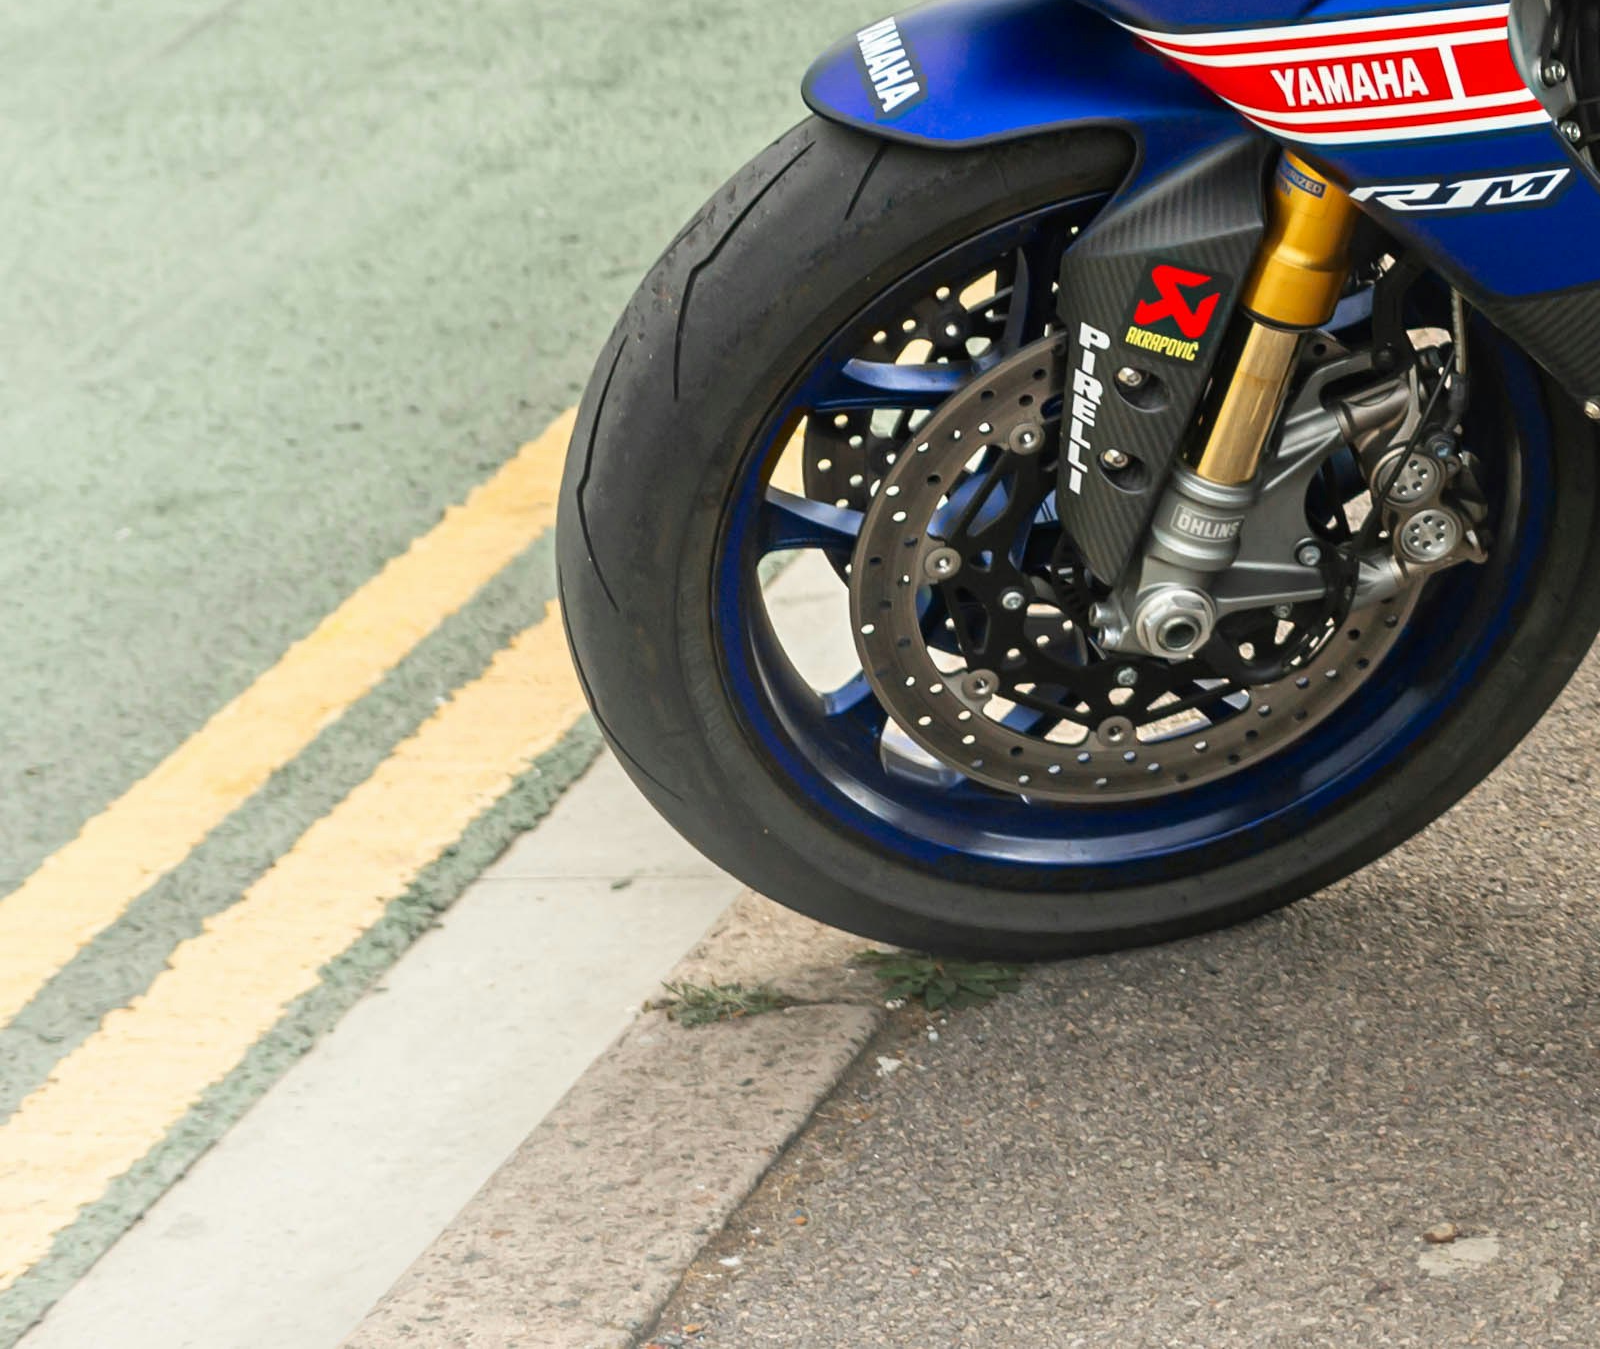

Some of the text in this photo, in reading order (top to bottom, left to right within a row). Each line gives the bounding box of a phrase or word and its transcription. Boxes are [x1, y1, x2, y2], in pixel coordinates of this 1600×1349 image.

[856, 16, 920, 113] YAMAHA
[1270, 57, 1429, 107] YAMAHA
[1349, 168, 1570, 211] R1M
[1067, 321, 1111, 495] PIRELLI
